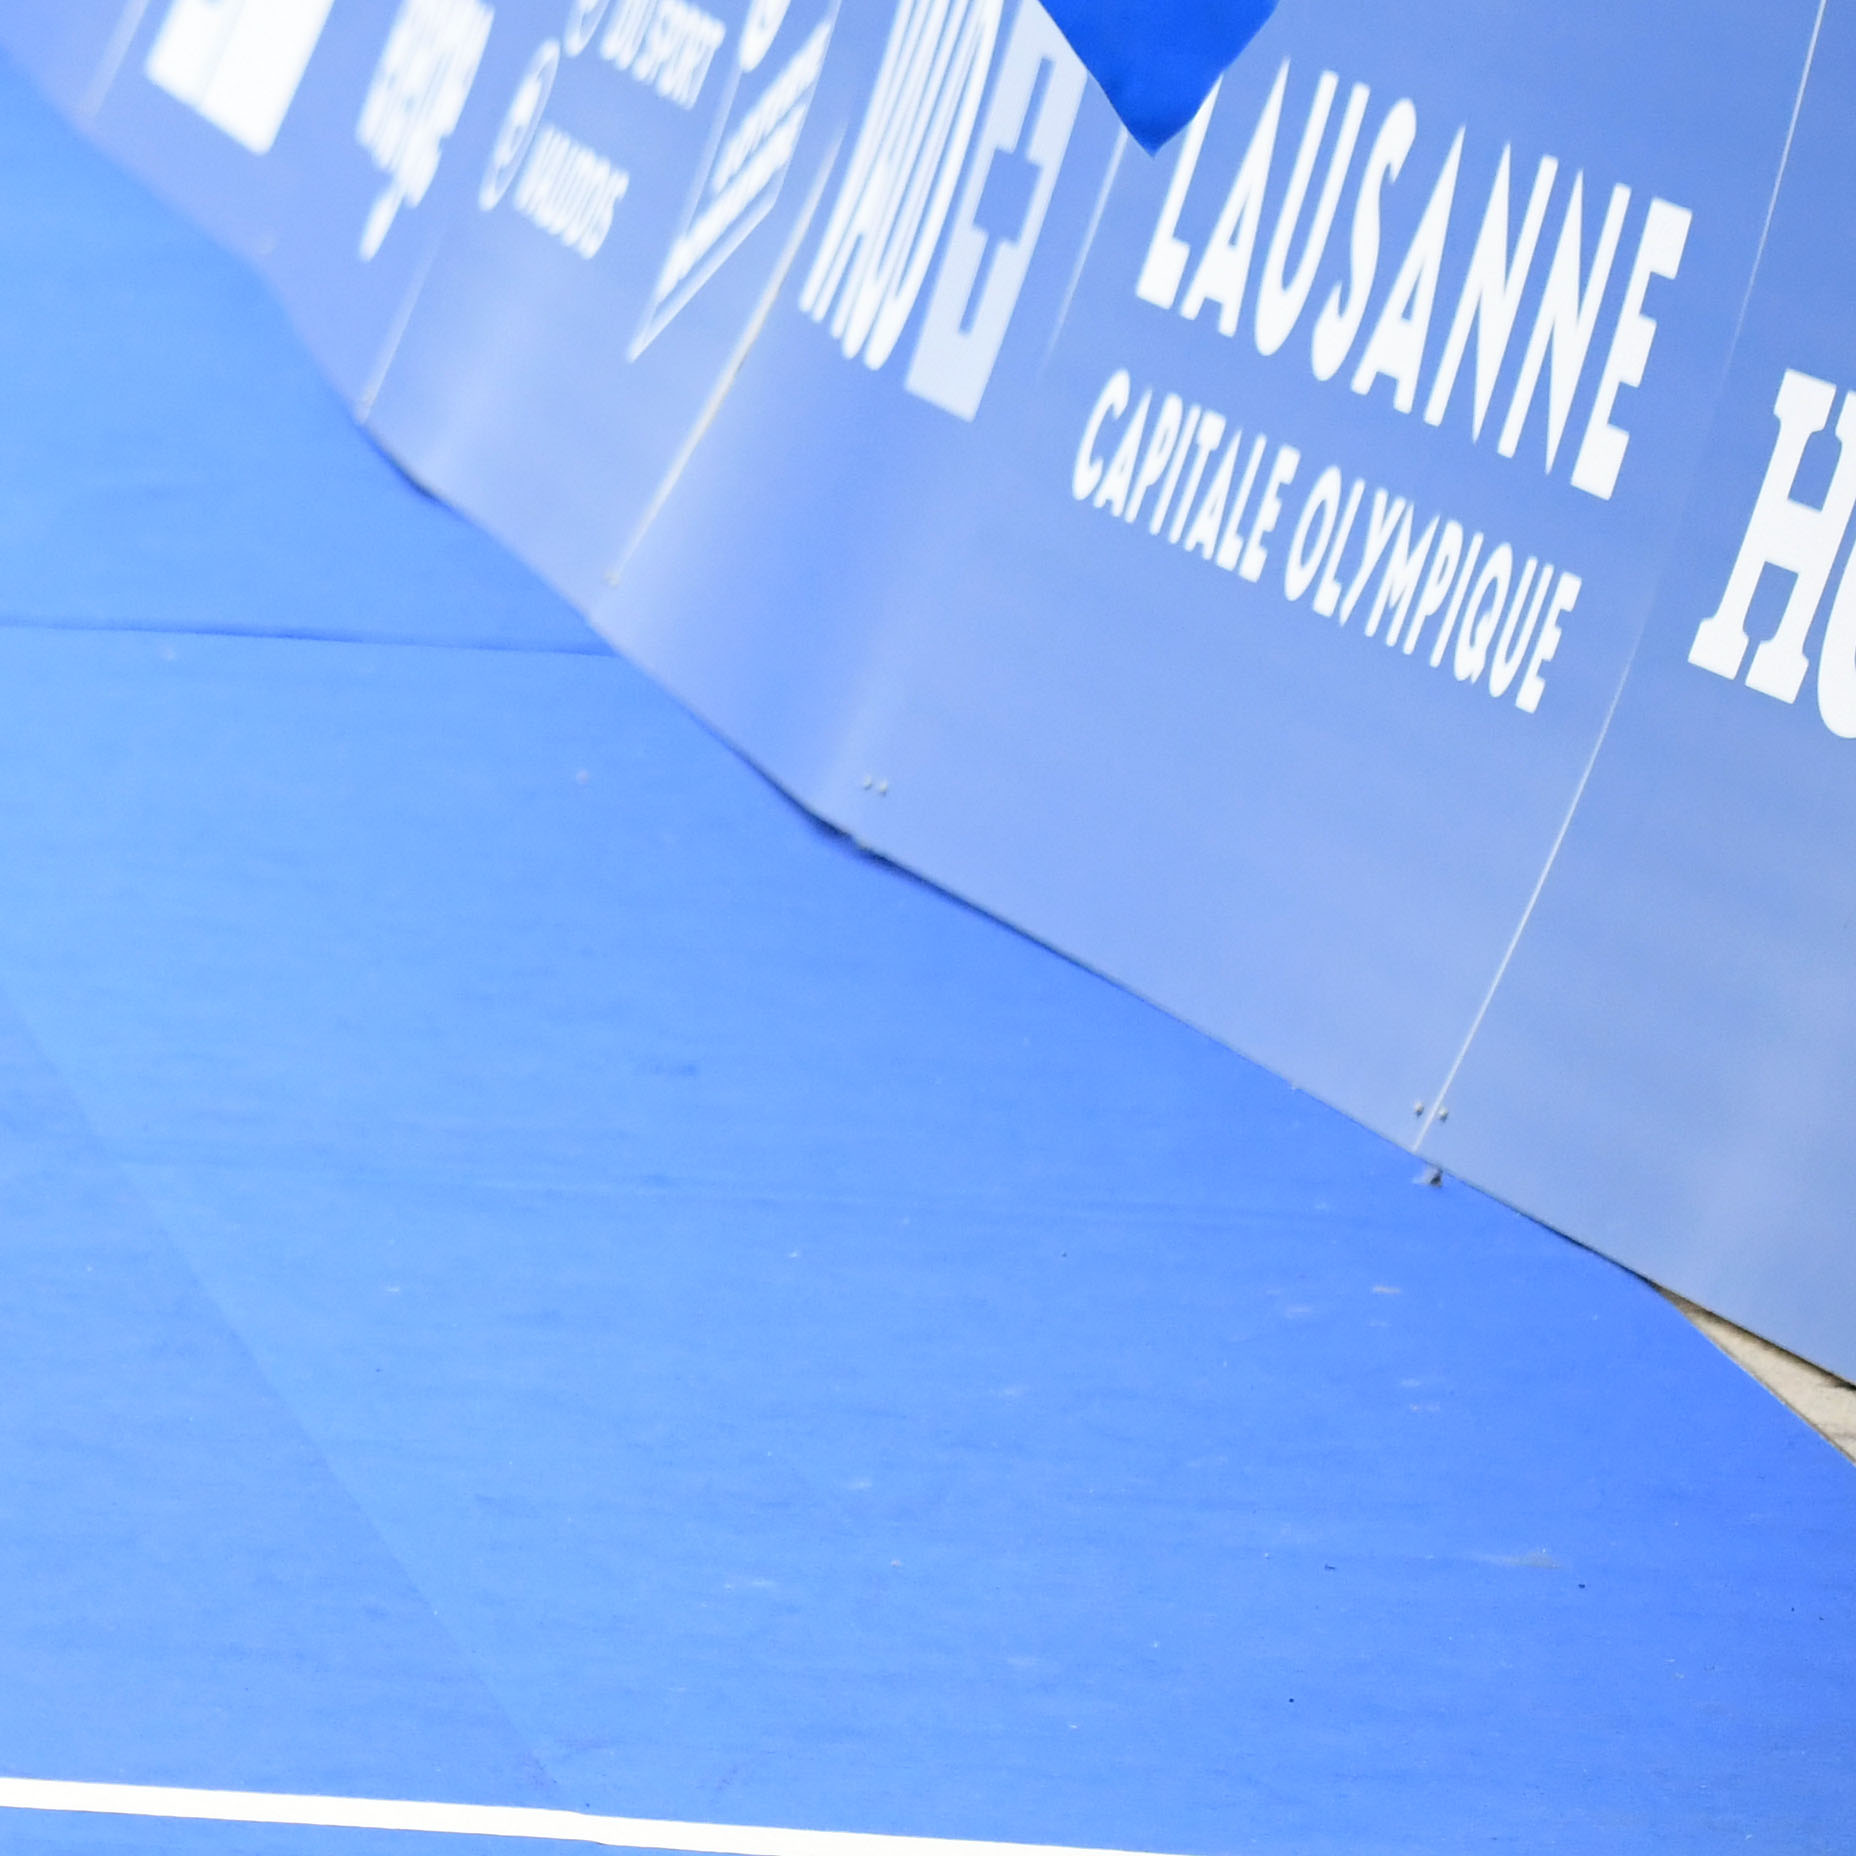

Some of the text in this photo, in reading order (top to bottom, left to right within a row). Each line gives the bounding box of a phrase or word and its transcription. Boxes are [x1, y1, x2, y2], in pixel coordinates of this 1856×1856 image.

[1135, 57, 1692, 500] LAUSANNE
[1072, 368, 1582, 714] CAPITALE OLYMPIQUE
